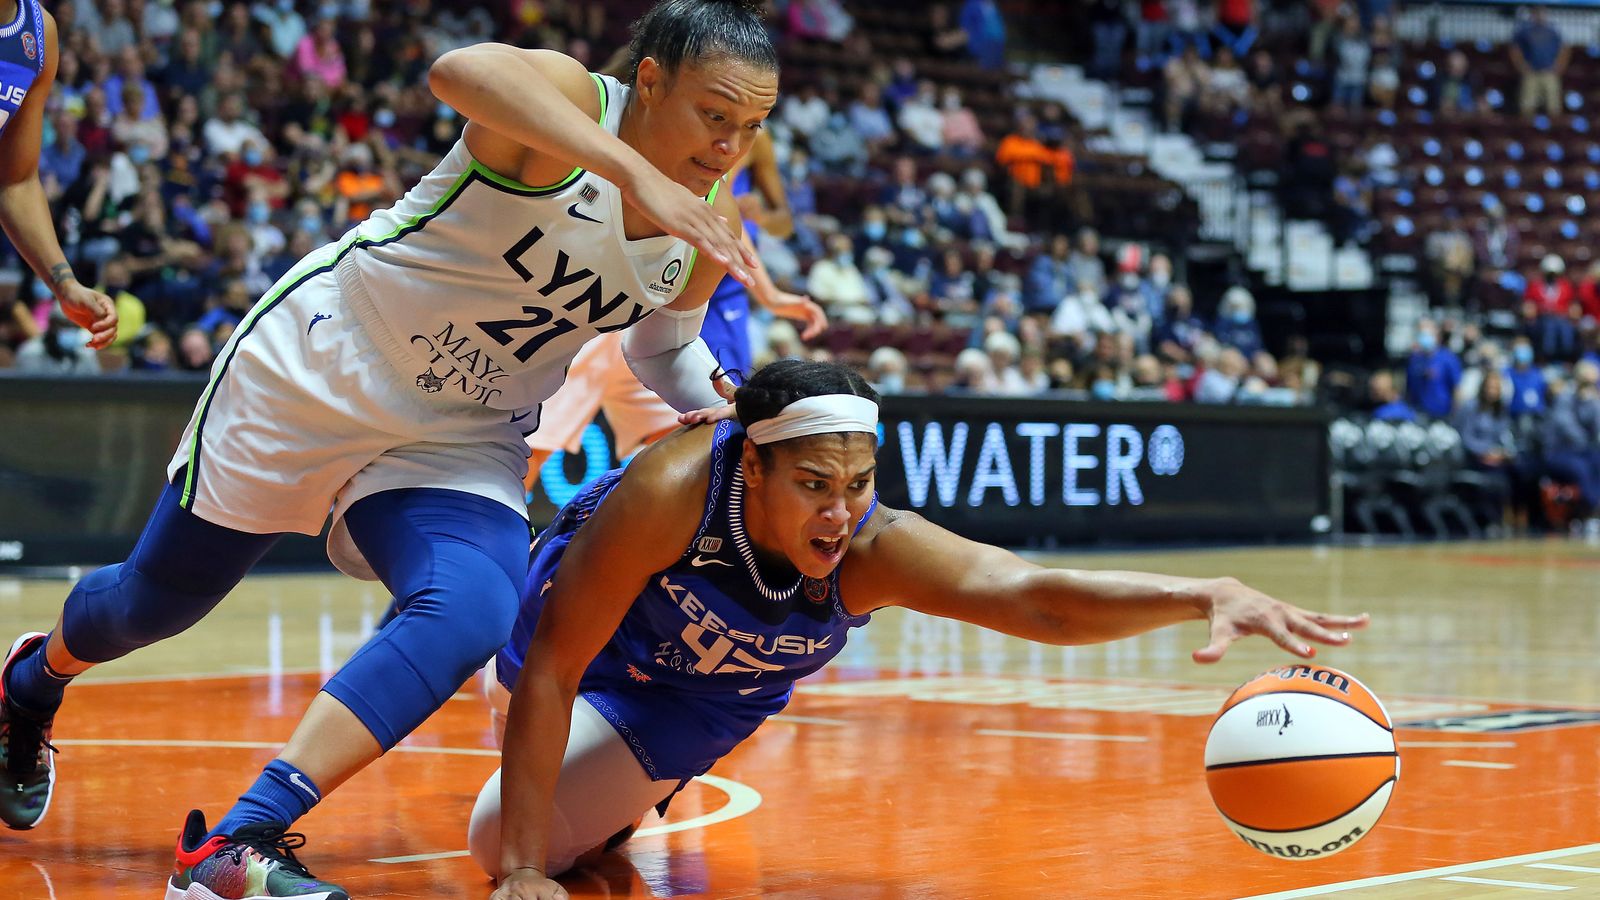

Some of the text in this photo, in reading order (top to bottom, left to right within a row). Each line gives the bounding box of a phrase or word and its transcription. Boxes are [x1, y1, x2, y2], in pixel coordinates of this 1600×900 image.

[475, 306, 579, 363] 21
[660, 575, 833, 655] KEESUSK
[1236, 826, 1366, 858] Wilson
